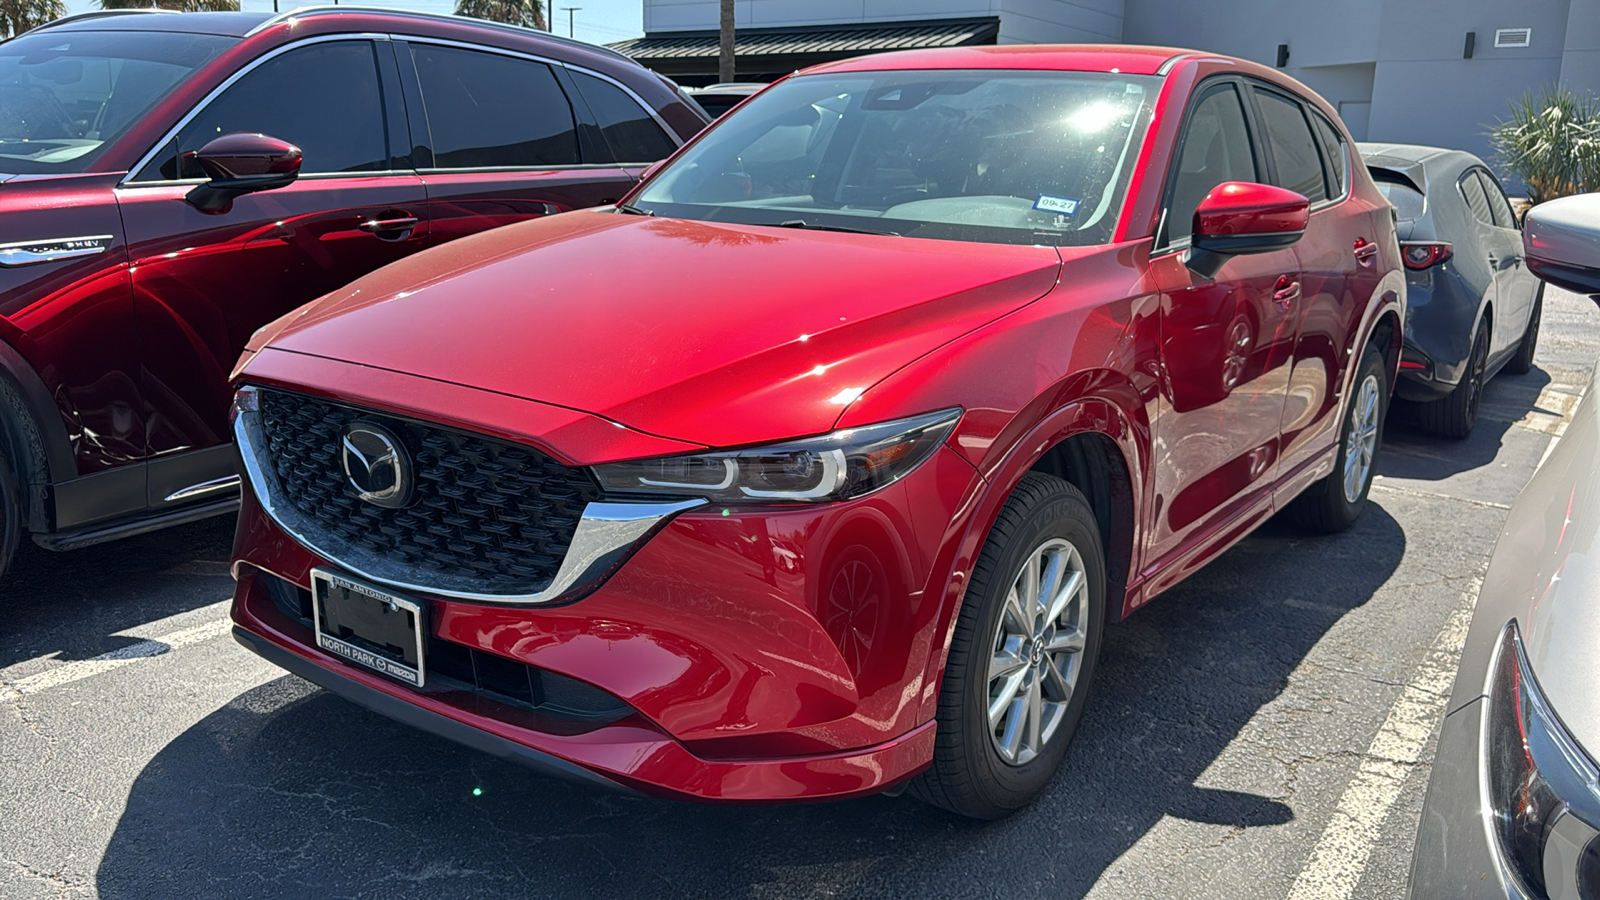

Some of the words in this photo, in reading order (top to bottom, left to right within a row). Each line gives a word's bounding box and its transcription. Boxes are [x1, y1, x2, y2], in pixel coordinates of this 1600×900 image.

[353, 585, 391, 602] ANTONIO
[322, 637, 351, 656] NORTH
[352, 650, 375, 667] PARK
